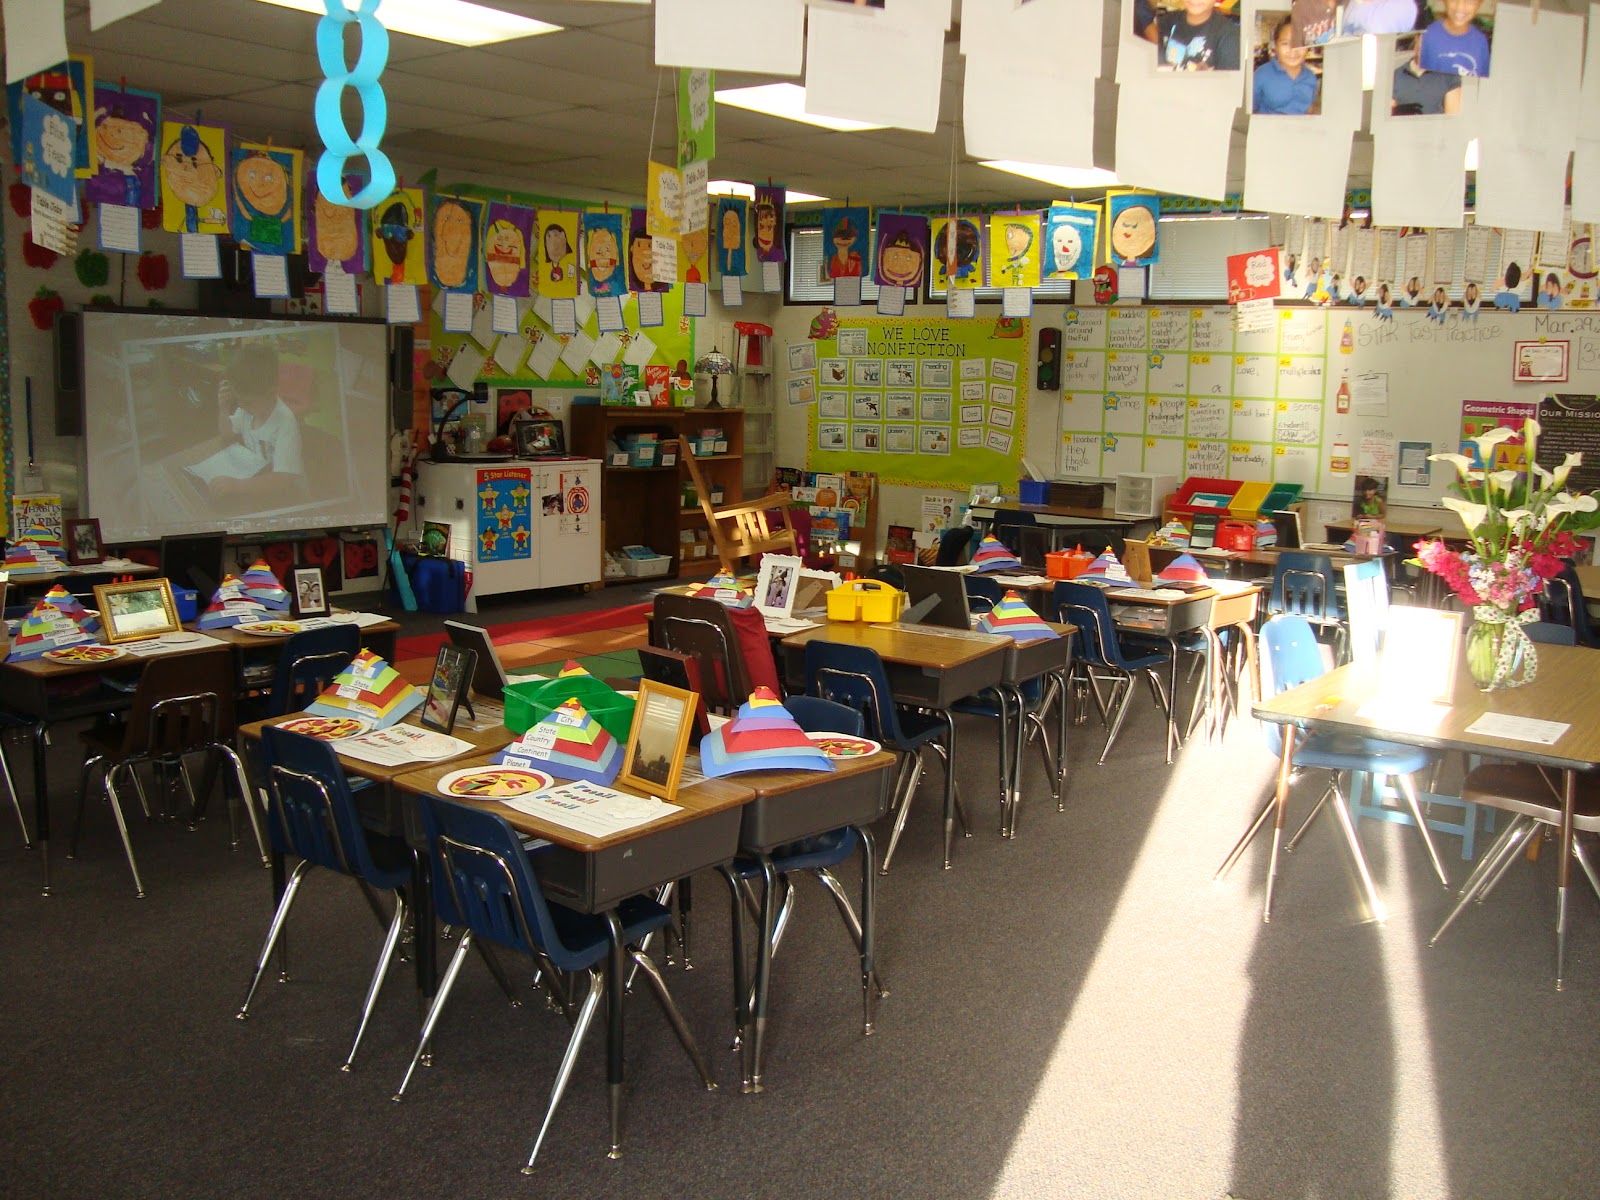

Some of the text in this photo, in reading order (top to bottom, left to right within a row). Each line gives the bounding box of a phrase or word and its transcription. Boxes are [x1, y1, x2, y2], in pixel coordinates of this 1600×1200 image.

[882, 326, 950, 341] WE LOVE
[867, 341, 966, 357] NONFICTION
[1464, 404, 1534, 416] Geometric Shapes
[484, 470, 528, 481] 5 Star Listener
[20, 500, 61, 514] 7 HABITS
[17, 516, 61, 528] HAPPY
[560, 715, 575, 725] City
[538, 725, 556, 736] State
[526, 733, 551, 745] Country
[517, 746, 548, 758] Continent
[506, 757, 526, 767] Planet
